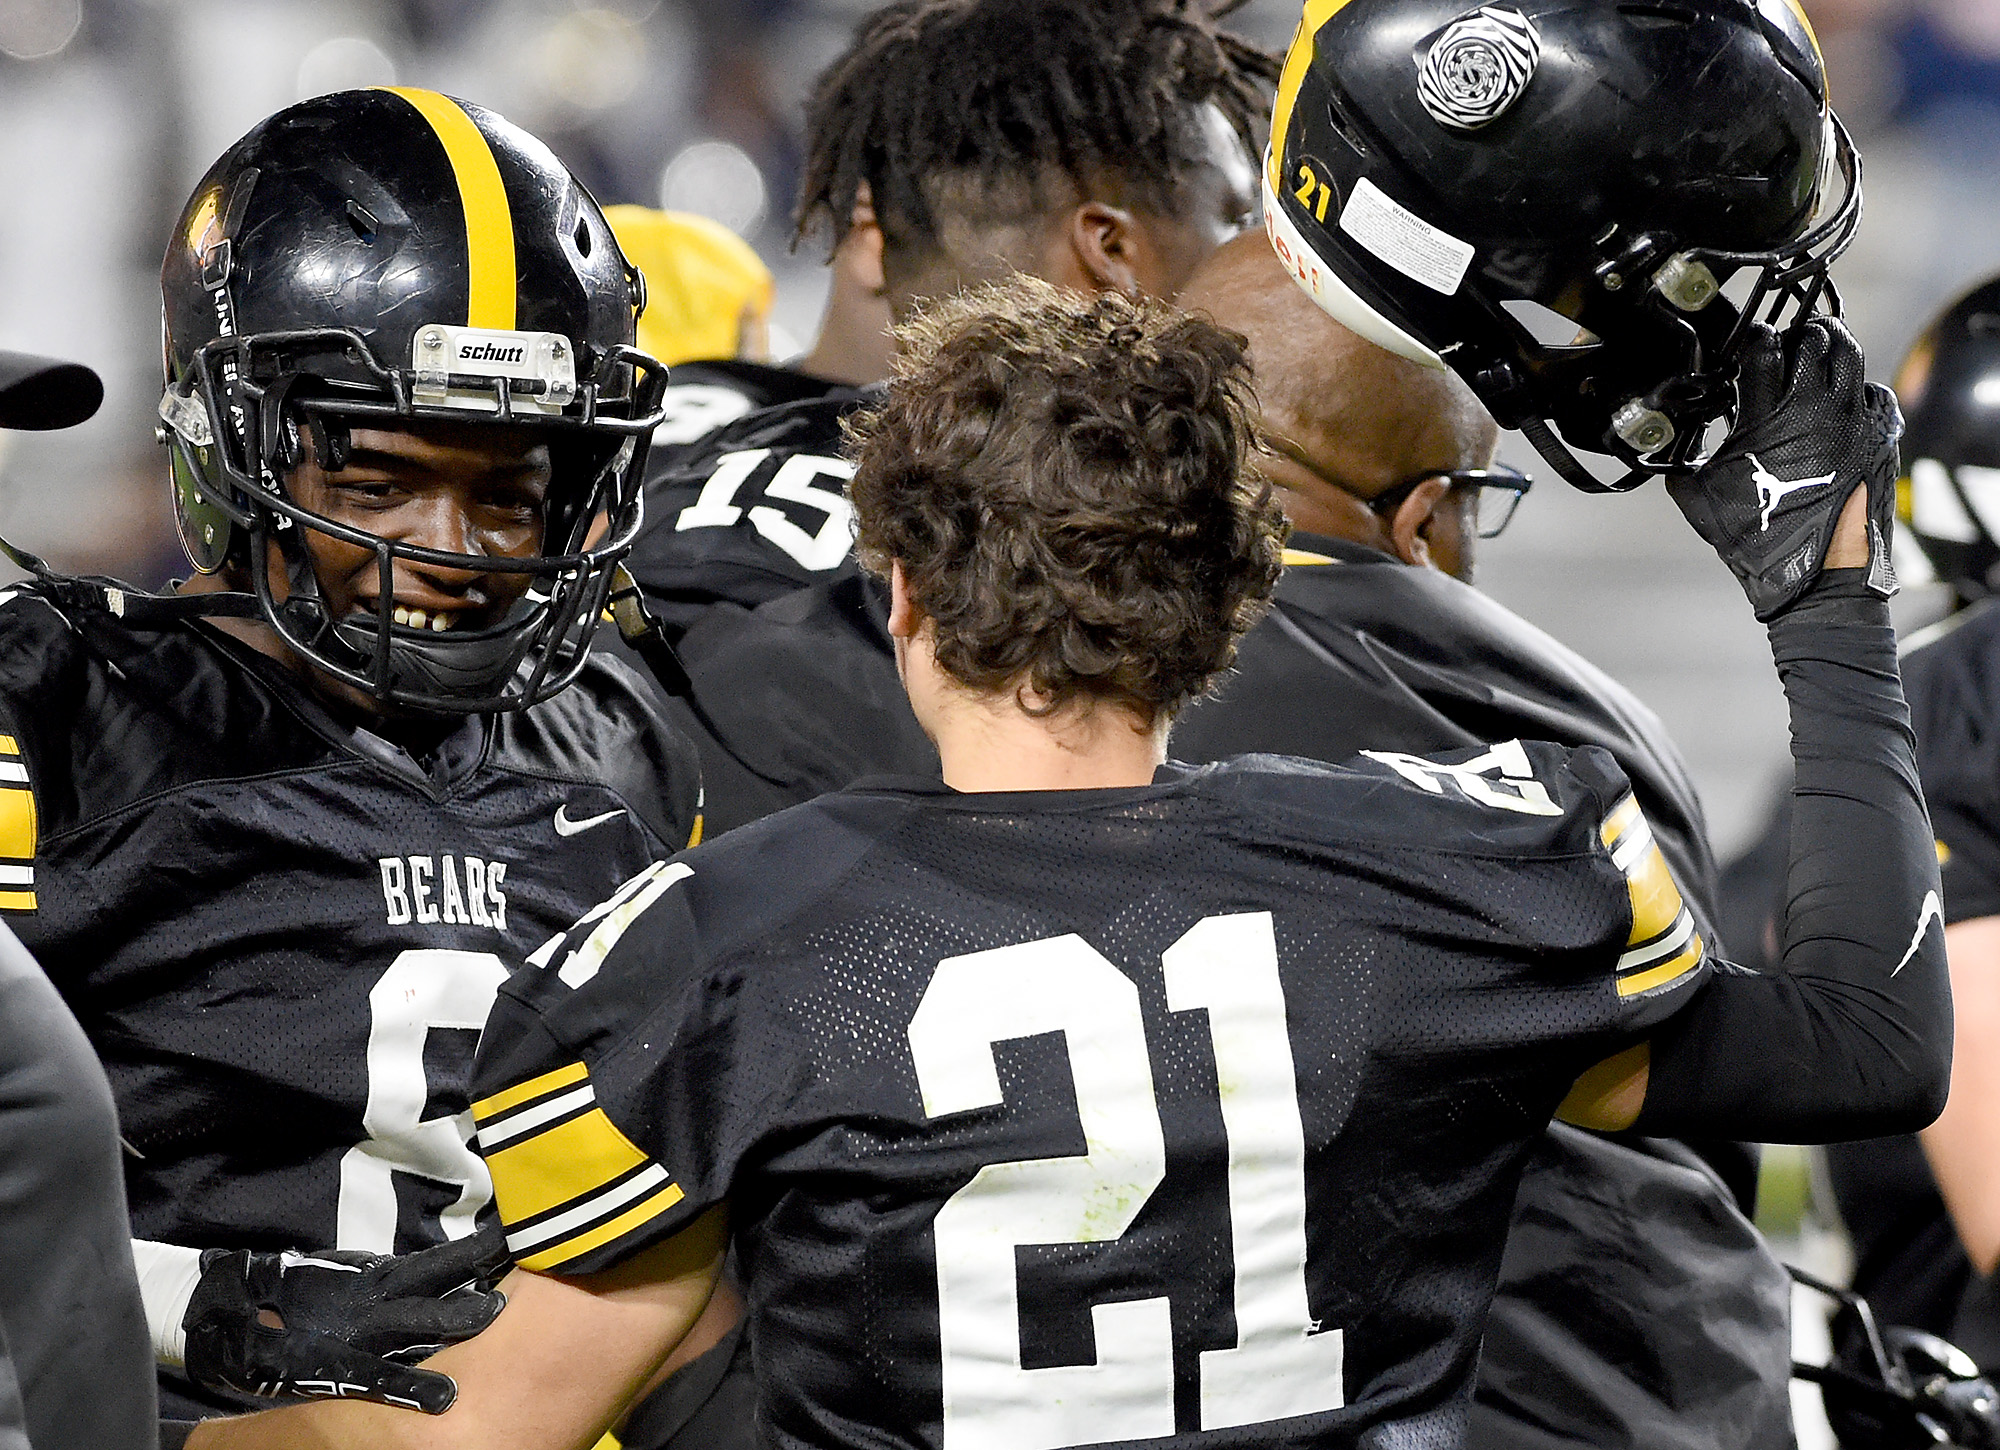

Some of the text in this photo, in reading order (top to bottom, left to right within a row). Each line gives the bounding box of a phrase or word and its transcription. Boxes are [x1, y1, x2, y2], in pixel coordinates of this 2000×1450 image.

[1294, 165, 1331, 223] 21
[1391, 206, 1432, 236] WARNING
[458, 342, 524, 362] schutt
[674, 448, 861, 571] 15
[378, 854, 507, 929] BEARS
[907, 911, 1344, 1450] 21
